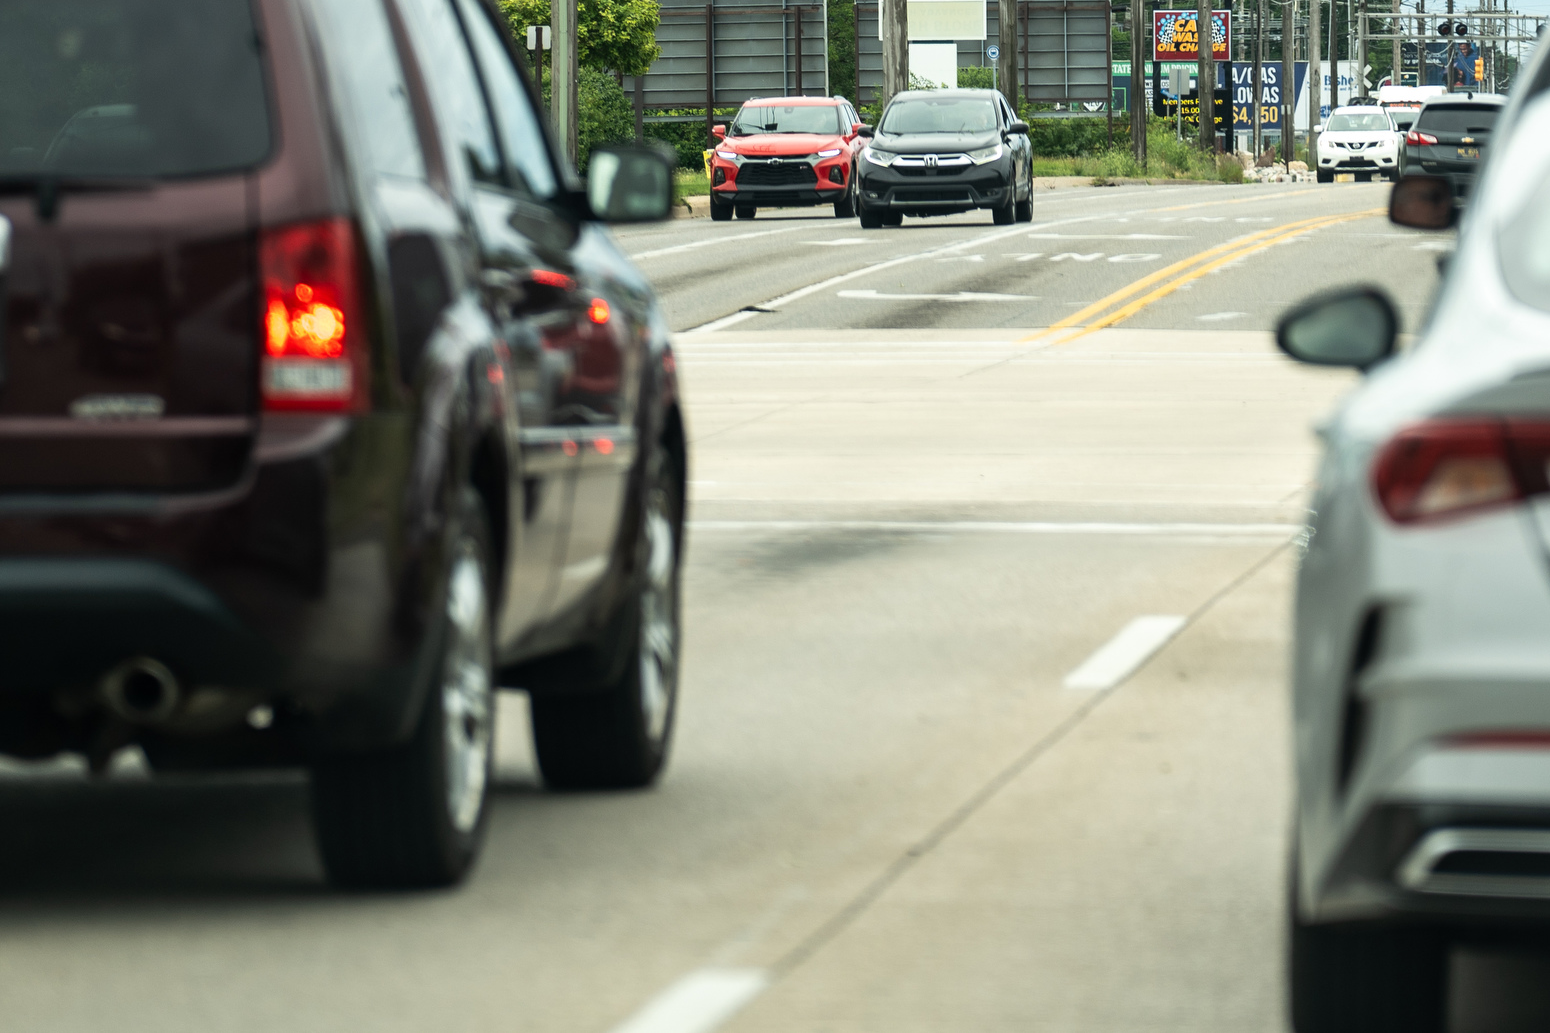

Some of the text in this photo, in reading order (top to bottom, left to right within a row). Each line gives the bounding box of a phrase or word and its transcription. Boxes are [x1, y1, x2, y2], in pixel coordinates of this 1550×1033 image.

[1174, 19, 1198, 32] CA
[1172, 32, 1198, 42] WAS
[1157, 43, 1177, 52] OIL
[1233, 106, 1279, 125] $4,50
